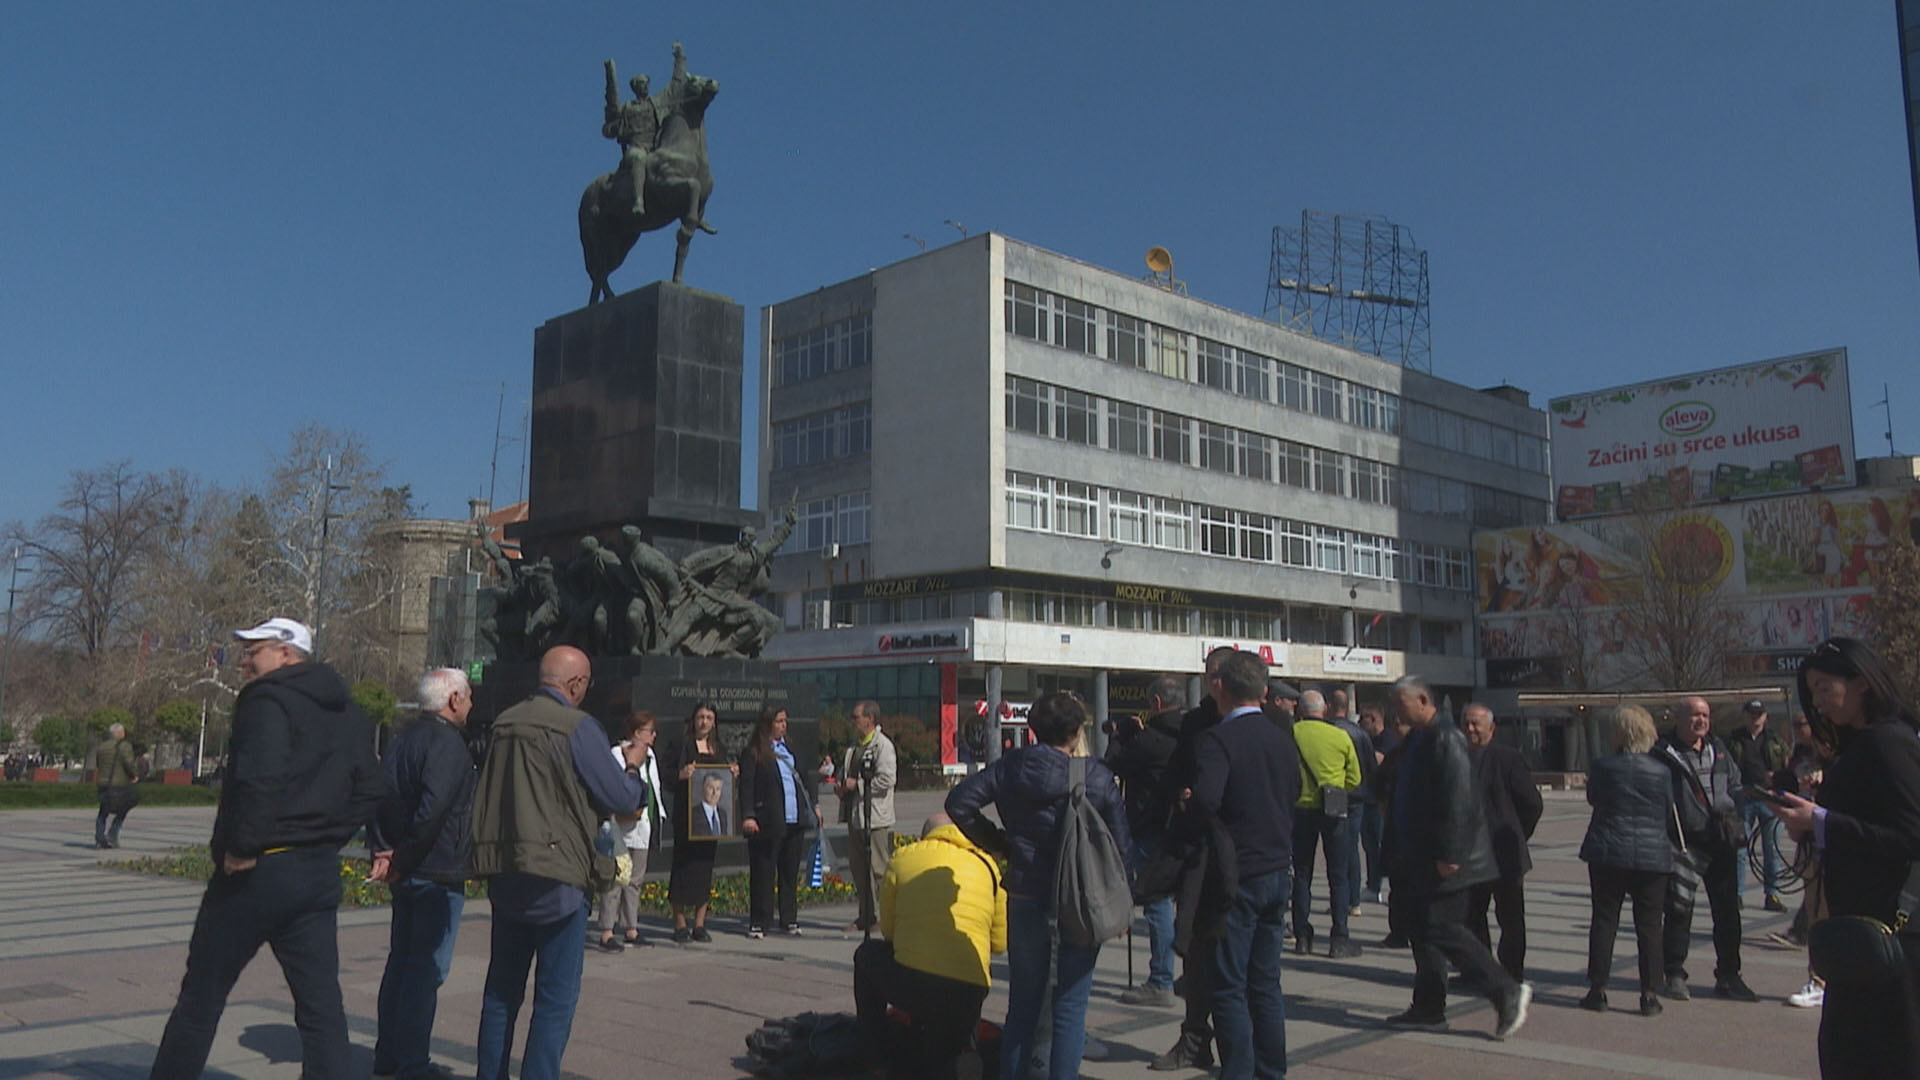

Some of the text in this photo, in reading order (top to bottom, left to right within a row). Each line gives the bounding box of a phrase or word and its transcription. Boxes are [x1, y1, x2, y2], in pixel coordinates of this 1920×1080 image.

[1665, 410, 1709, 426] aleva
[1588, 424, 1801, 467] Začini su srce ukusa
[863, 579, 917, 598] MOZZART
[1115, 584, 1166, 602] MOZZART
[1110, 688, 1147, 701] MOZZA
